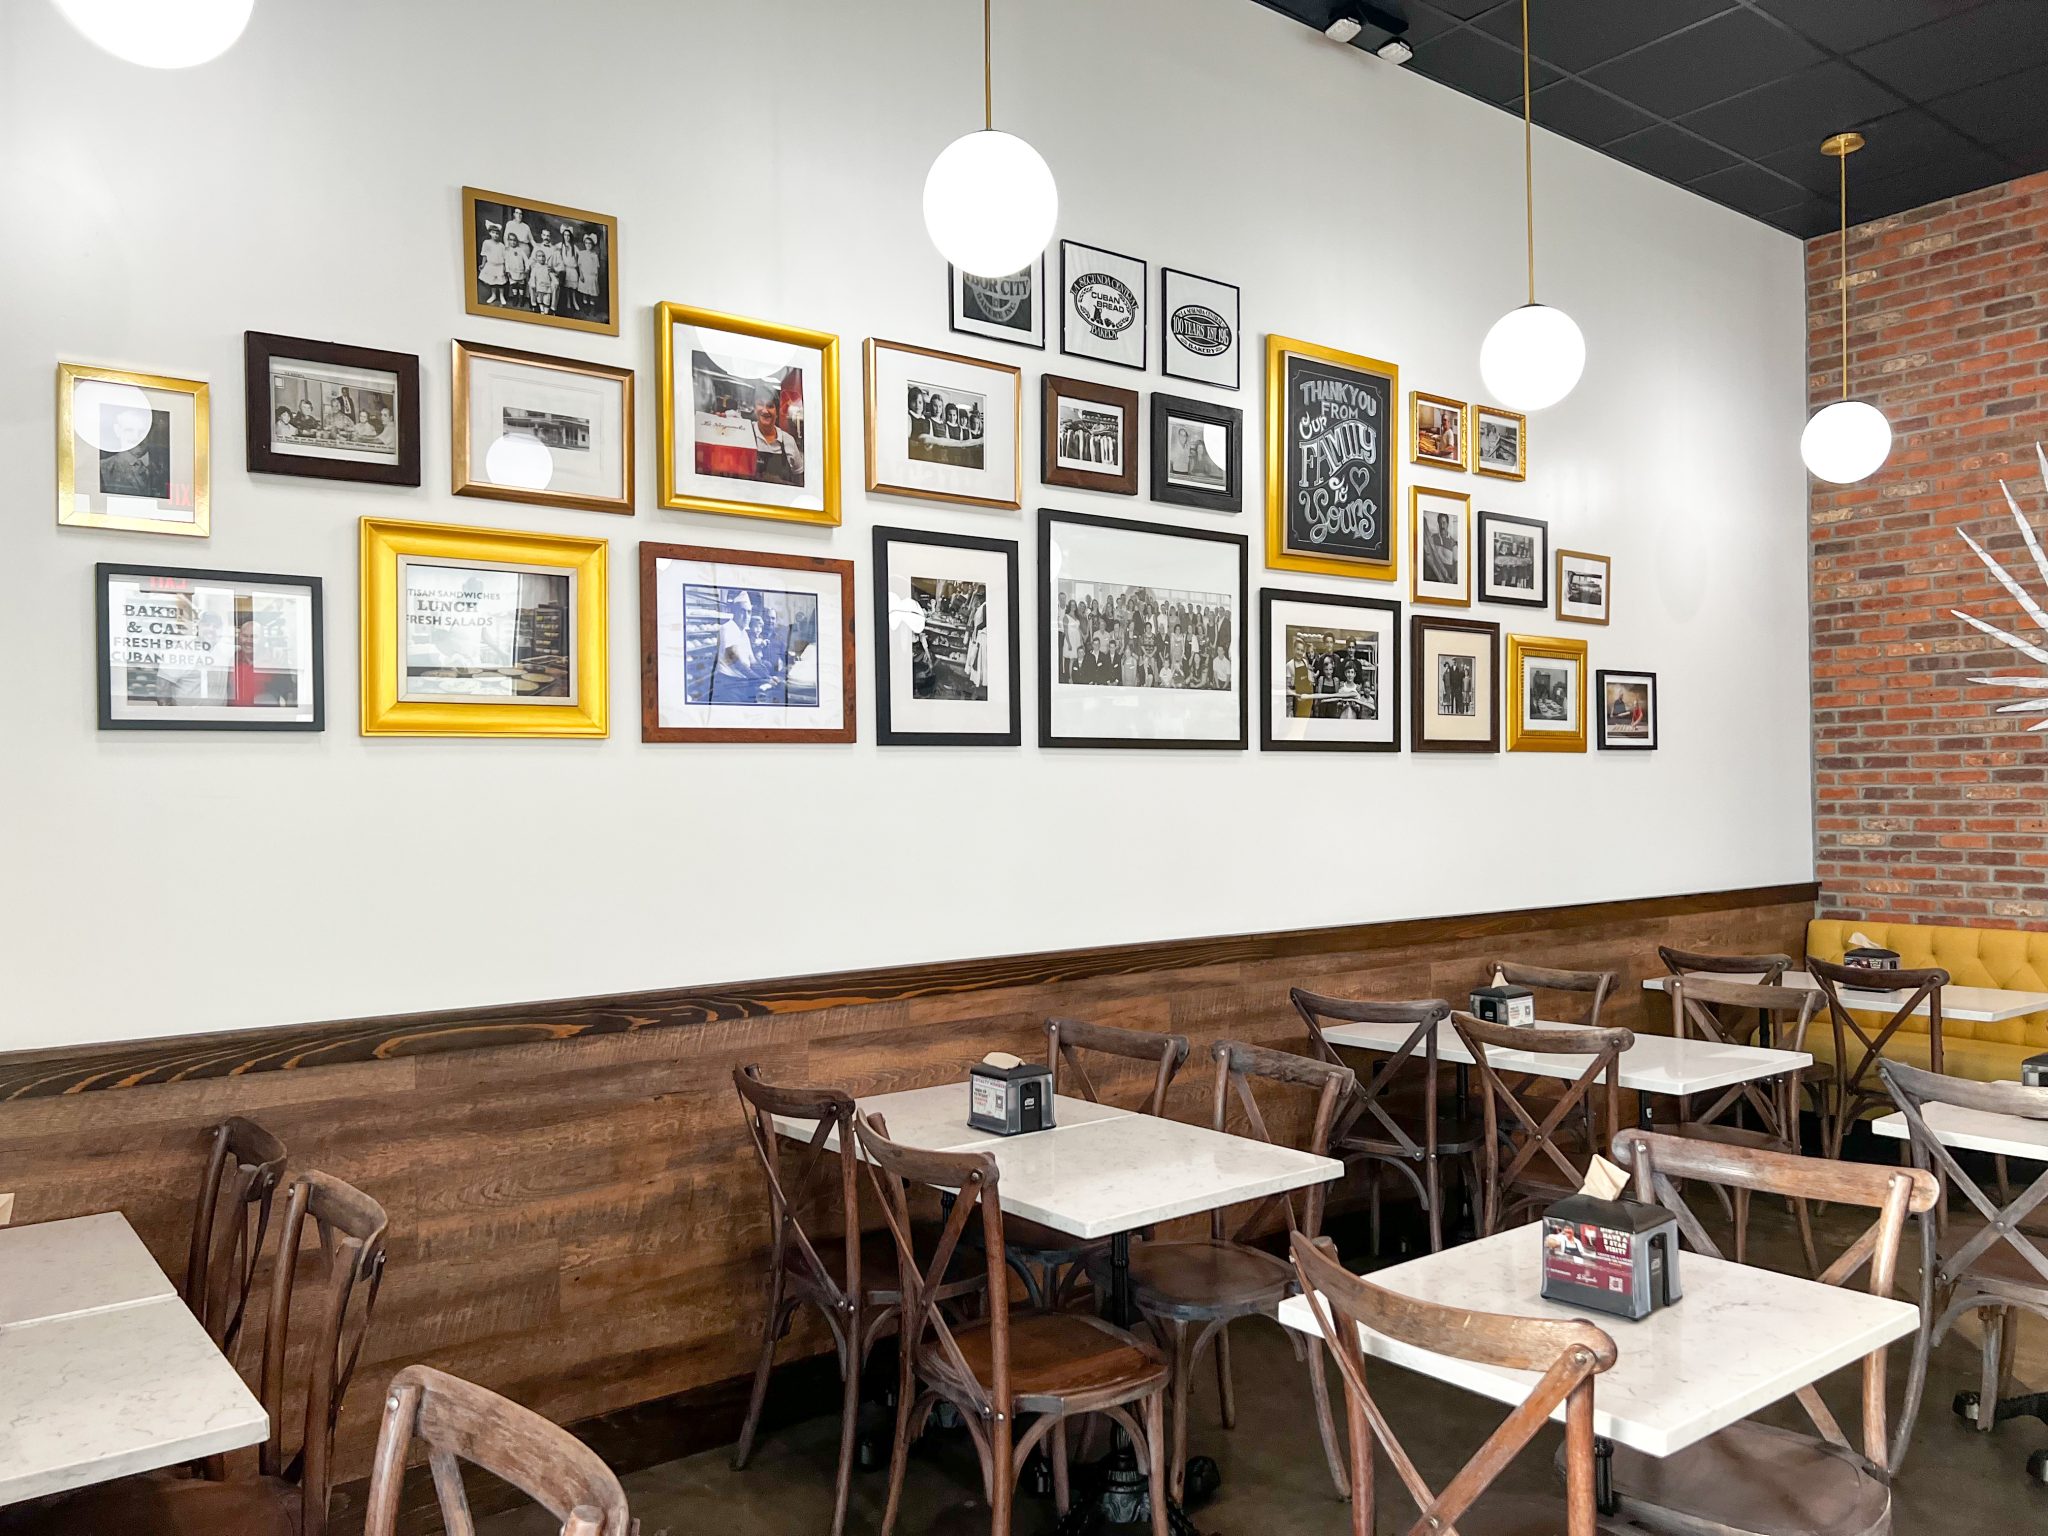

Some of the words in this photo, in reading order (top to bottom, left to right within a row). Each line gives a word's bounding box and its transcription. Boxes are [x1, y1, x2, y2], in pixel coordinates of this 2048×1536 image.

[1000, 279, 1029, 296] CITY
[1078, 274, 1111, 288] SEGUNDA
[1091, 291, 1121, 304] CUBAN
[1096, 300, 1125, 313] BREAD
[1091, 325, 1118, 339] BAKERY
[1173, 315, 1184, 333] 100
[1184, 320, 1205, 337] YEARS
[1188, 343, 1215, 353] BAKERY
[1299, 380, 1348, 405] THANK
[1347, 385, 1377, 417] YOU
[1321, 401, 1359, 419] FROM
[1298, 488, 1378, 543] Yours
[407, 588, 436, 597] TISAN
[438, 590, 501, 600] SANDWICHES
[417, 599, 478, 612] LUNCH
[126, 621, 142, 633] &
[444, 616, 493, 627] SALADS
[113, 636, 161, 649] FRESH
[165, 639, 212, 652] BAKED
[111, 650, 165, 664] CUBAN
[169, 654, 215, 666] BREAD
